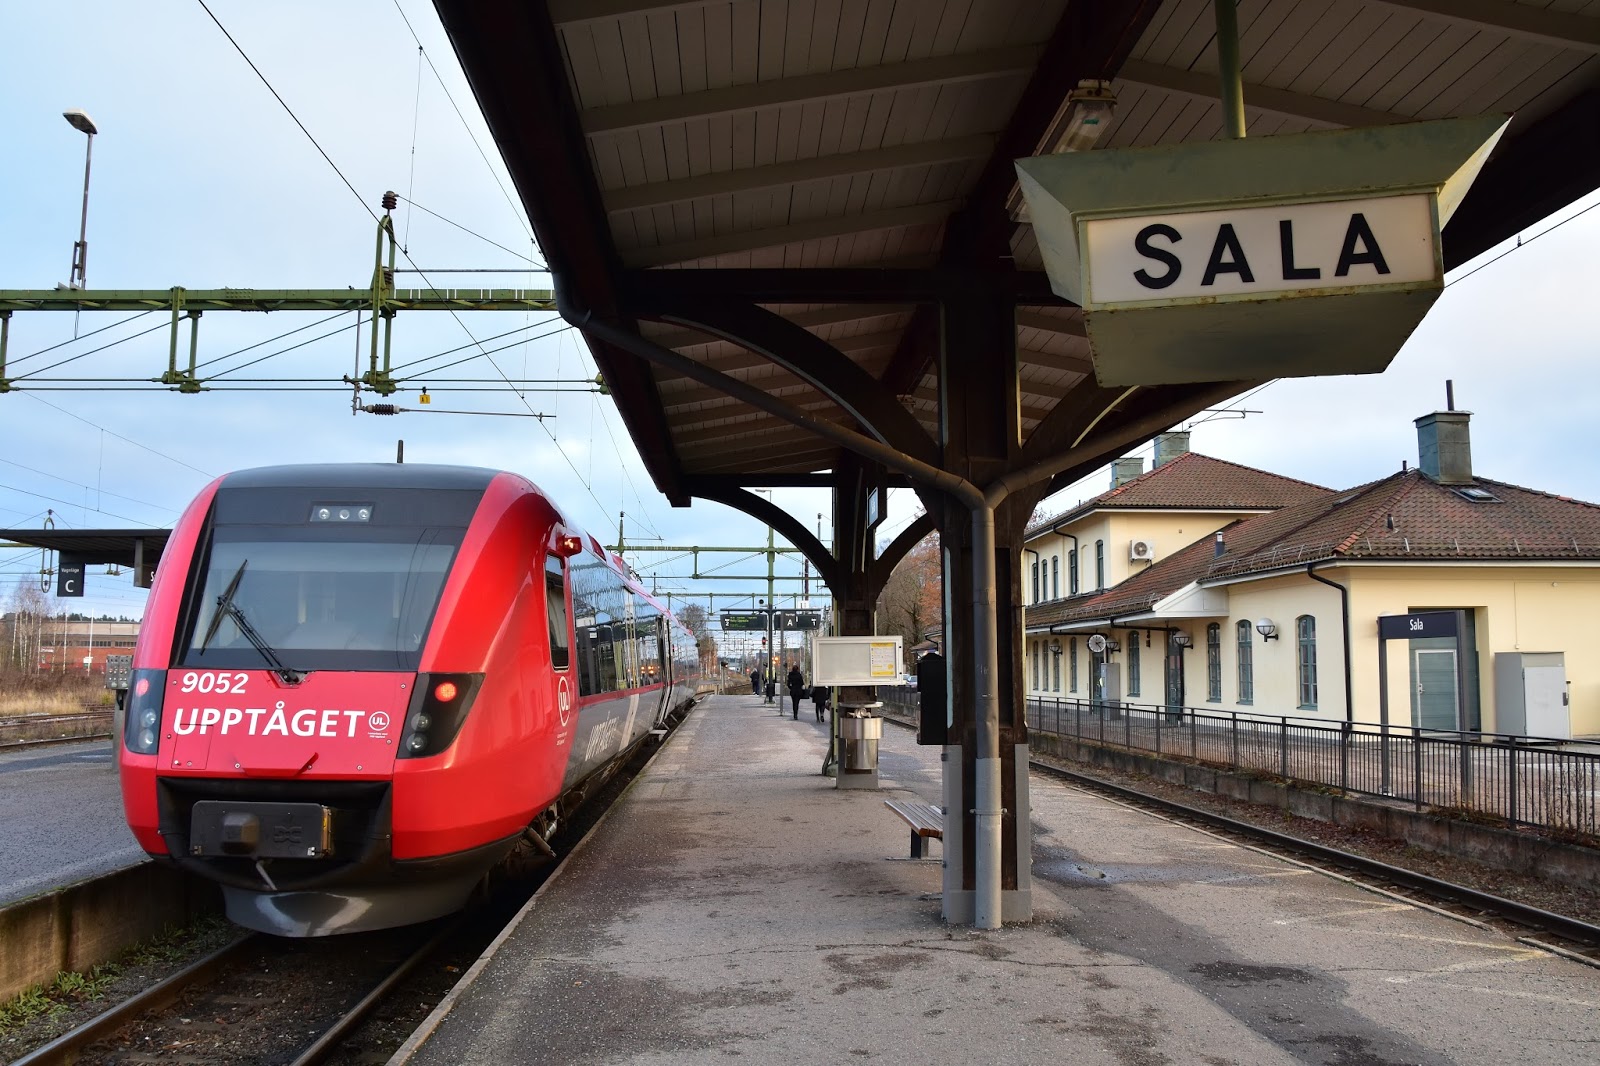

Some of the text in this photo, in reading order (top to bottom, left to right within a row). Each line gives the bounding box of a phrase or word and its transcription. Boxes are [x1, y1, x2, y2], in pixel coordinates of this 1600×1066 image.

[1133, 213, 1391, 289] SALA
[65, 580, 74, 593] C
[787, 618, 793, 626] A
[1409, 618, 1424, 631] Sala
[181, 672, 249, 694] 9052
[173, 700, 366, 738] UPPTÅGET
[372, 716, 386, 726] UL
